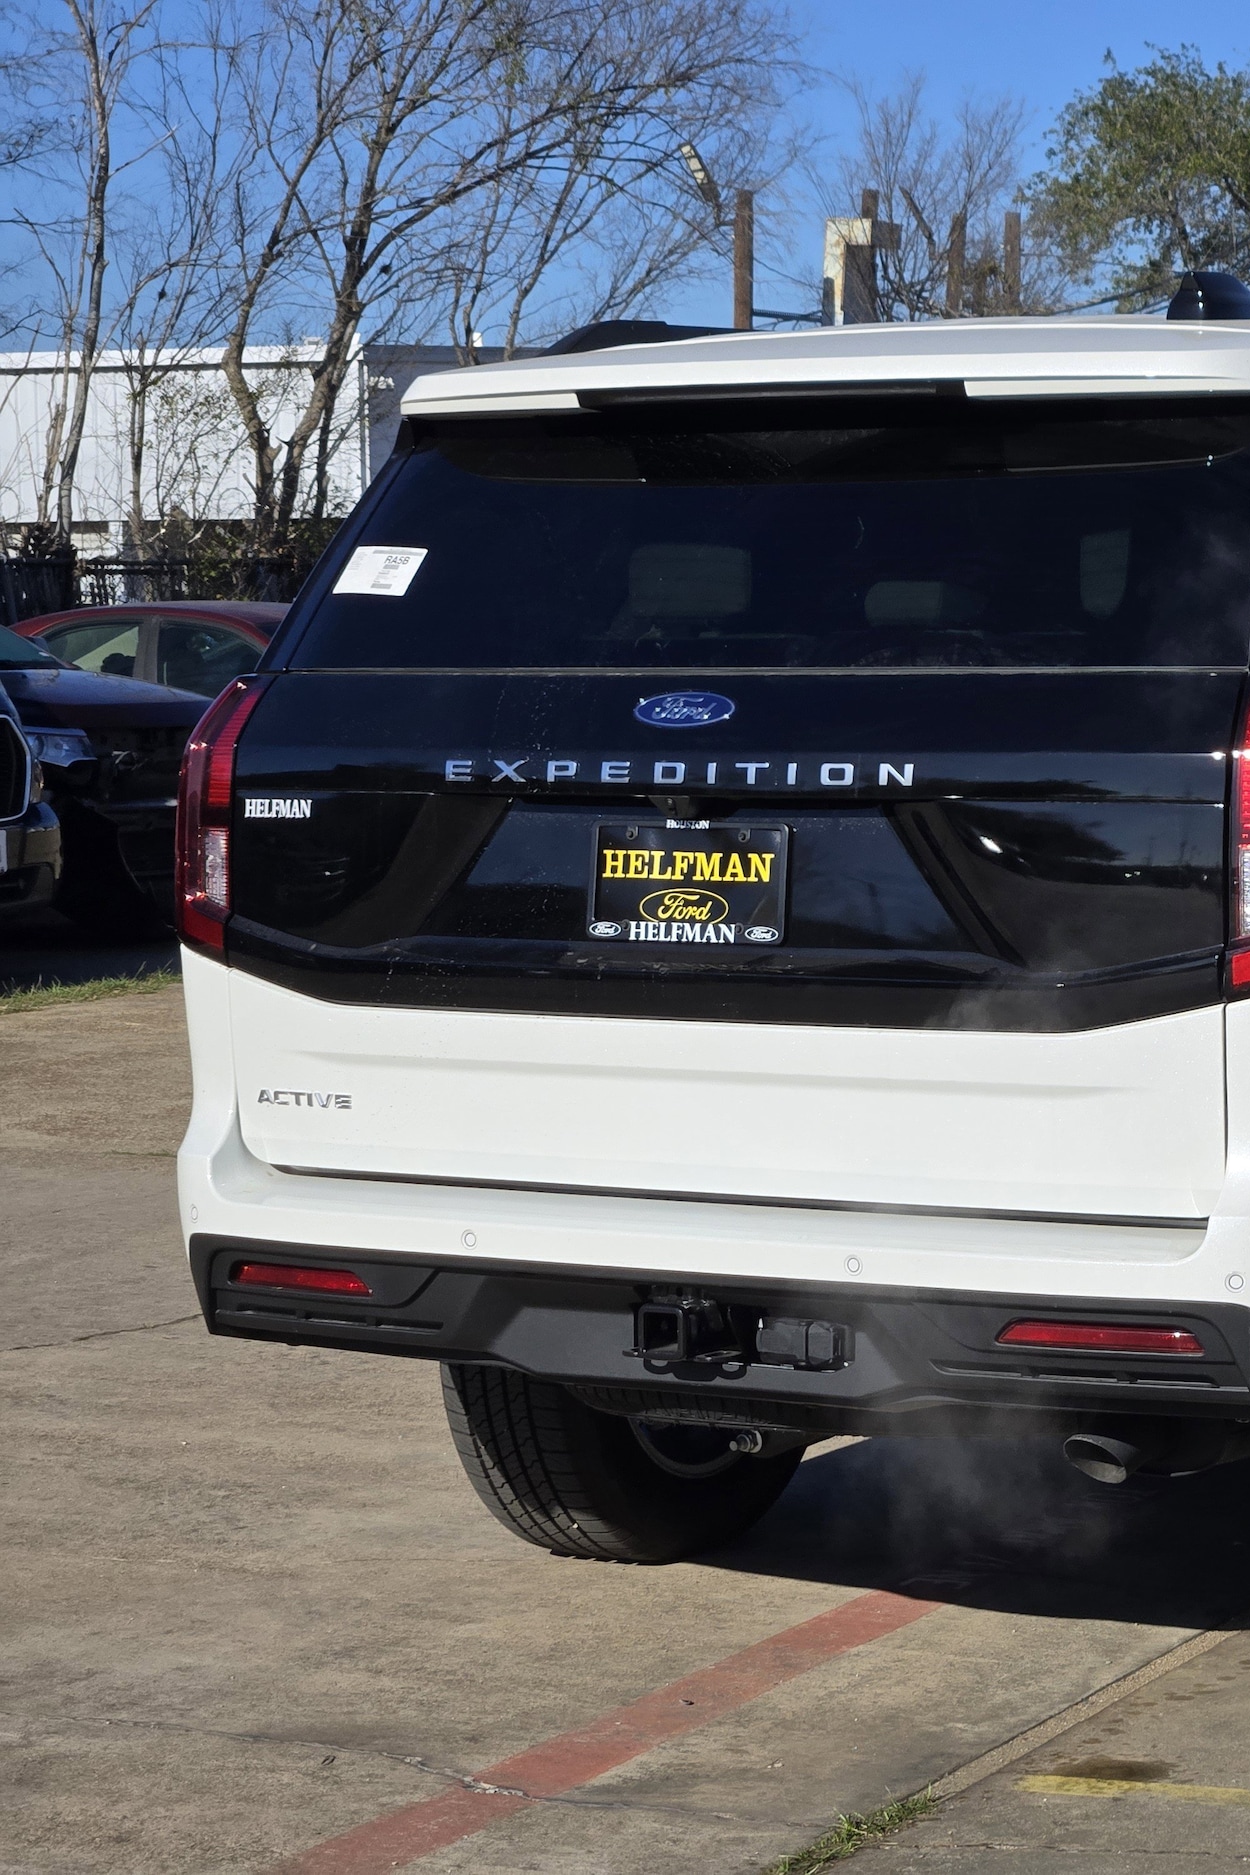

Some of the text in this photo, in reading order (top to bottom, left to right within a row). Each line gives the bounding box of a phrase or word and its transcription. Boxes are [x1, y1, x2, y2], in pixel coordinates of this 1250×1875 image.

[651, 697, 717, 719] Ford
[445, 760, 915, 786] EXPEDITION
[244, 798, 312, 818] HELFMAN
[602, 849, 775, 882] HELFMAN
[657, 893, 713, 921] Ford
[628, 920, 736, 944] HELFMAN
[257, 1089, 352, 1109] ACTIVE
